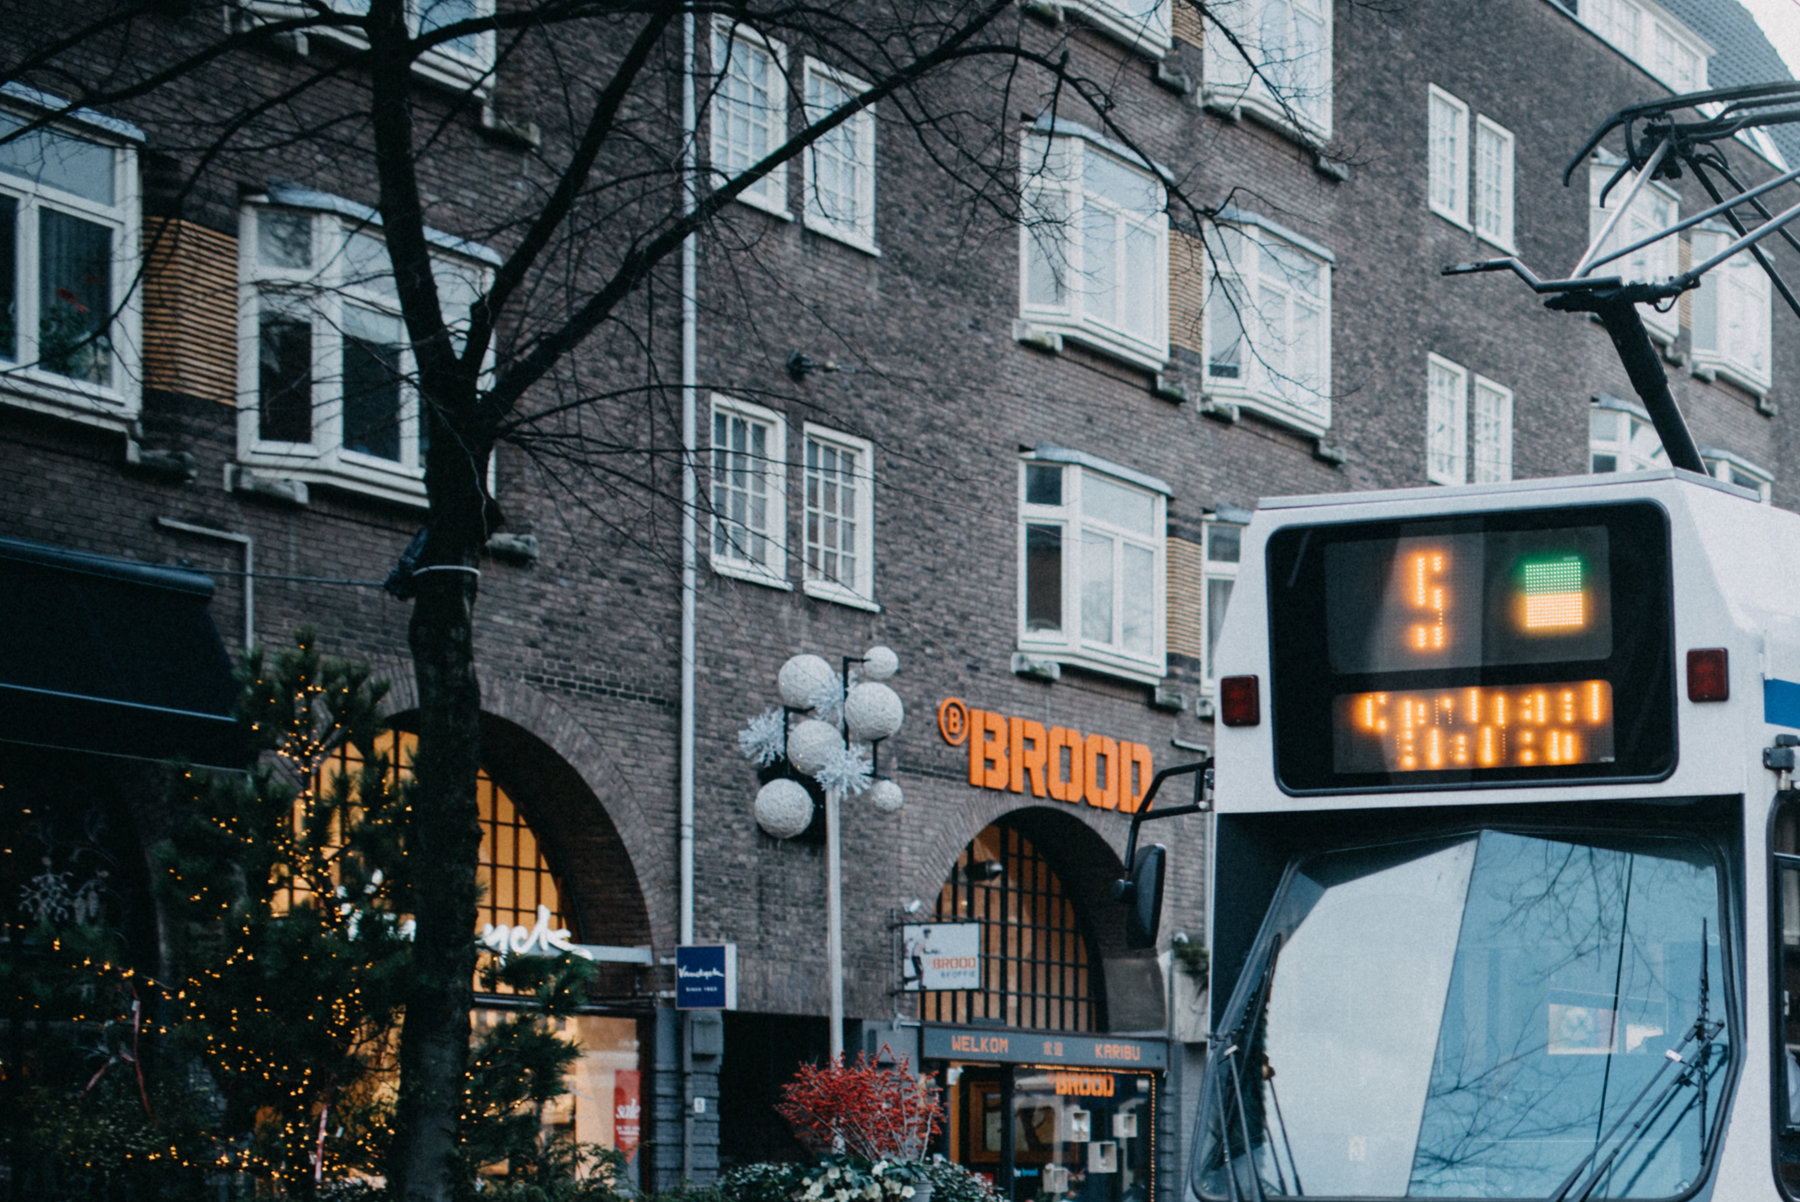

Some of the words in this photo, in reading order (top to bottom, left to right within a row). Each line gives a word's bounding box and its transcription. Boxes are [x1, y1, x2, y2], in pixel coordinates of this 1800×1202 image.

[969, 708, 1153, 814] BROOD
[933, 957, 976, 969] BROOD
[952, 1035, 1009, 1054] WELKOM
[1095, 1043, 1141, 1061] KARIBU
[1056, 1072, 1115, 1097] BROOD
[616, 1098, 641, 1119] sale
